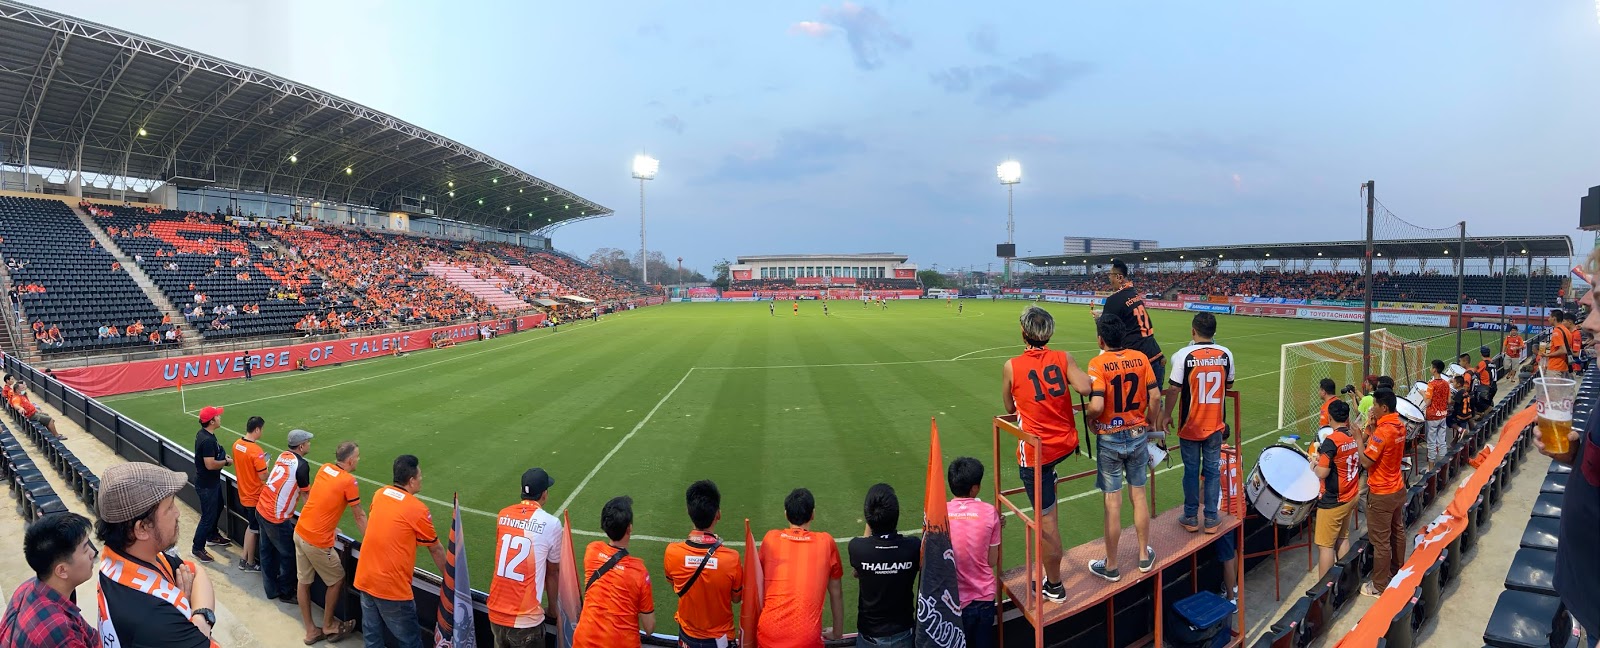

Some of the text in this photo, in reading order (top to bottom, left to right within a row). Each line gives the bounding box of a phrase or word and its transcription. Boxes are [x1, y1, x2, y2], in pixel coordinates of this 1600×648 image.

[163, 350, 290, 381] UNIVERSE
[299, 345, 334, 362] OF
[350, 335, 410, 356] TALENT
[1103, 361, 1119, 372] NOK
[1028, 365, 1066, 402] 19
[1110, 372, 1140, 413] 12
[1196, 371, 1221, 404] 12
[497, 533, 532, 582] 12
[861, 561, 913, 571] THAILAND
